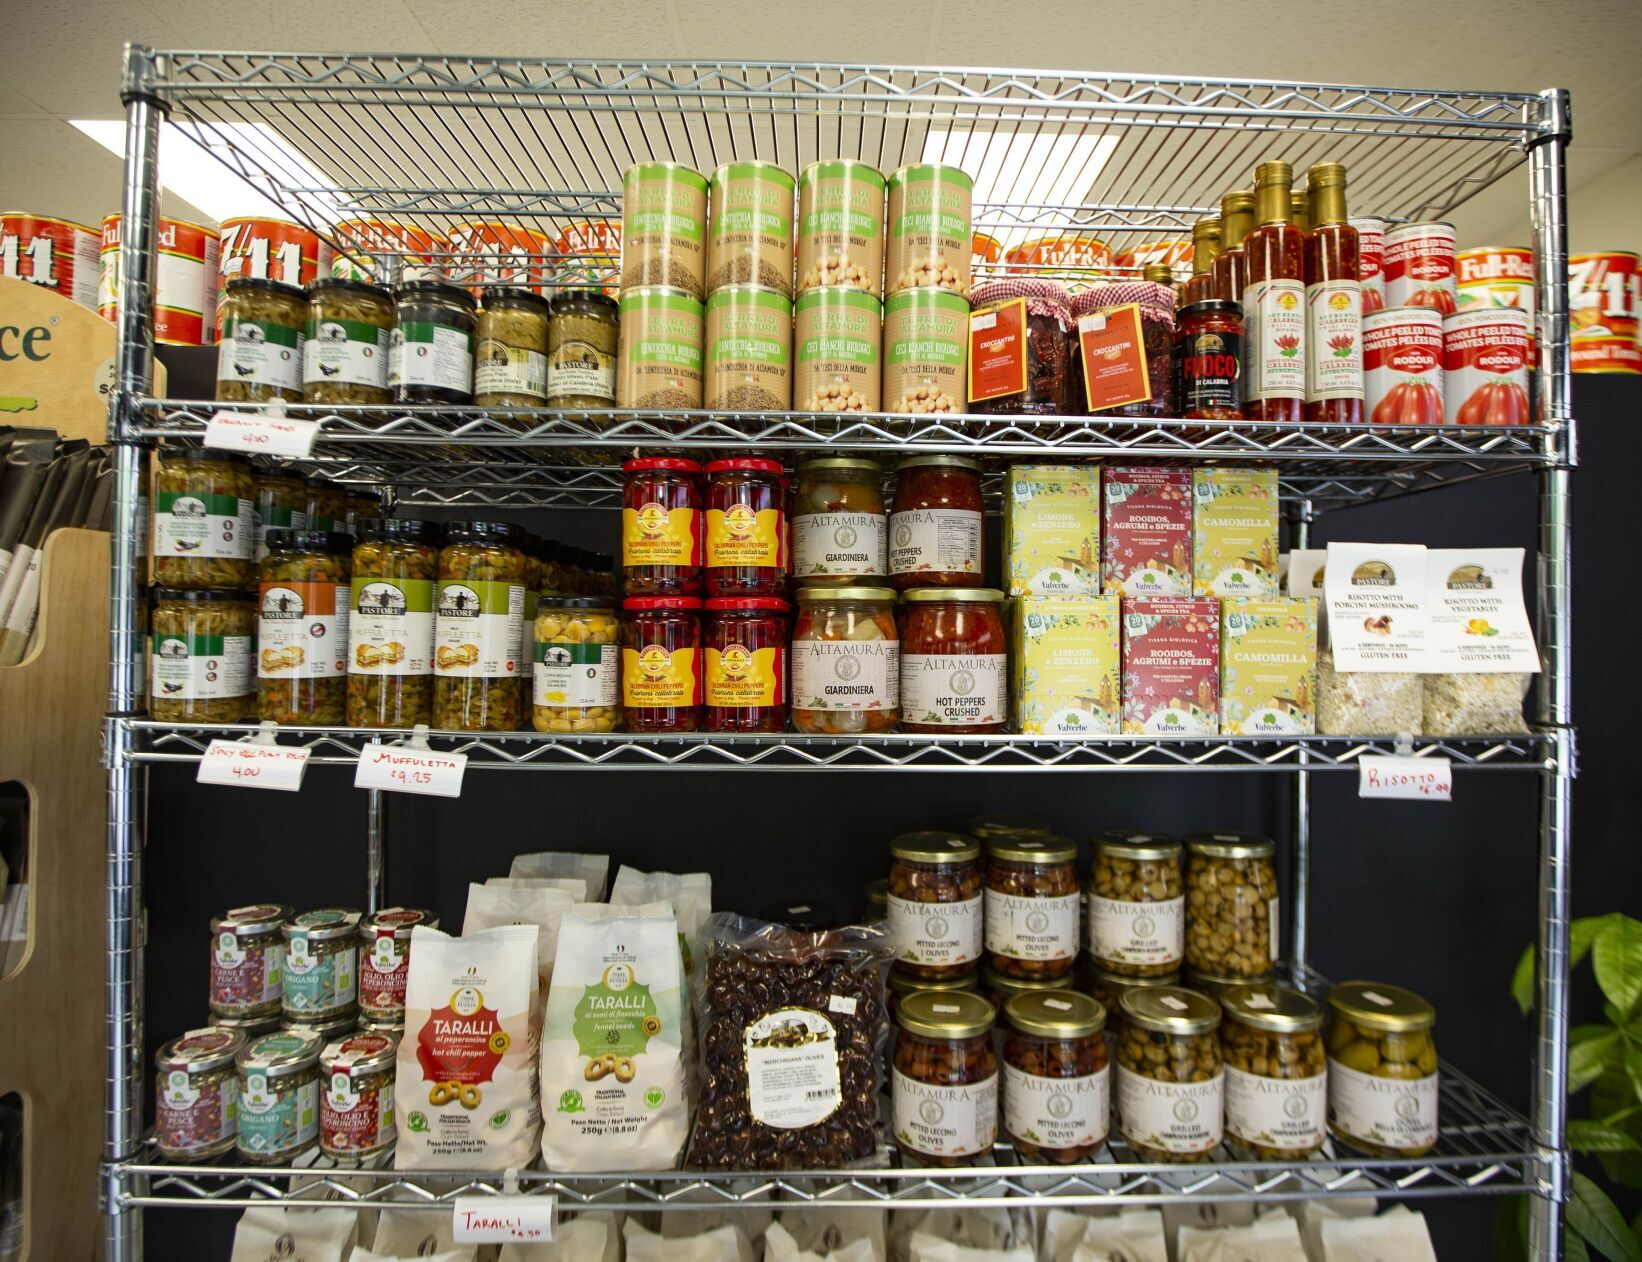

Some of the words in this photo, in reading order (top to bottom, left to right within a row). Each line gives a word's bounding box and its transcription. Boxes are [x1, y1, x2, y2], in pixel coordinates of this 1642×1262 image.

[1184, 354, 1236, 380] FUOCO
[1202, 378, 1230, 386] CALABRIA
[810, 516, 877, 528] ALTAMURA
[1128, 515, 1170, 524] ROOIBOS,
[1203, 518, 1271, 528] CAMOMILLA
[1113, 522, 1148, 530] AGRUMI
[1155, 522, 1186, 530] SPEZIE
[897, 547, 922, 556] PEPPERS
[825, 553, 869, 562] GIARDINIERA
[361, 607, 400, 616] PASTORE
[440, 609, 475, 618] PASTORE
[809, 642, 885, 656] ALTAMURA
[1150, 649, 1195, 659] ROOIBOS,
[1133, 658, 1172, 666] AGRUMI
[1178, 657, 1212, 666] SPEZIE
[1234, 653, 1308, 664] CAMOMILLA
[923, 657, 997, 671] ALTAMURA
[824, 685, 874, 695] GIARDINIERA
[936, 696, 952, 706] HOT
[954, 696, 986, 706] PEPPERS
[944, 707, 980, 717] CRUSHED
[372, 753, 456, 769] MUFFULETTA
[588, 996, 646, 1010] TARALLI
[608, 1010, 615, 1018] di
[615, 1010, 646, 1019] finocchio
[433, 1020, 493, 1036] TARALLI
[593, 1022, 615, 1032] fennel
[615, 1022, 635, 1030] seeds
[444, 1035, 487, 1045] peperoncino
[432, 1048, 445, 1057] hot
[446, 1048, 461, 1057] chili
[461, 1049, 487, 1058] pepper
[900, 1077, 970, 1102] ALTAMURA
[1021, 1078, 1095, 1095] ALTAMURA
[1146, 1080, 1218, 1098] ALTAMURA
[625, 1116, 648, 1124] Weight
[1037, 1119, 1059, 1128] PITTED
[581, 1126, 603, 1135] 250g
[909, 1121, 929, 1134] PITTED
[1048, 1130, 1075, 1138] OLIVES
[918, 1135, 944, 1146] OLIVES
[461, 1210, 521, 1231] TARALLI
